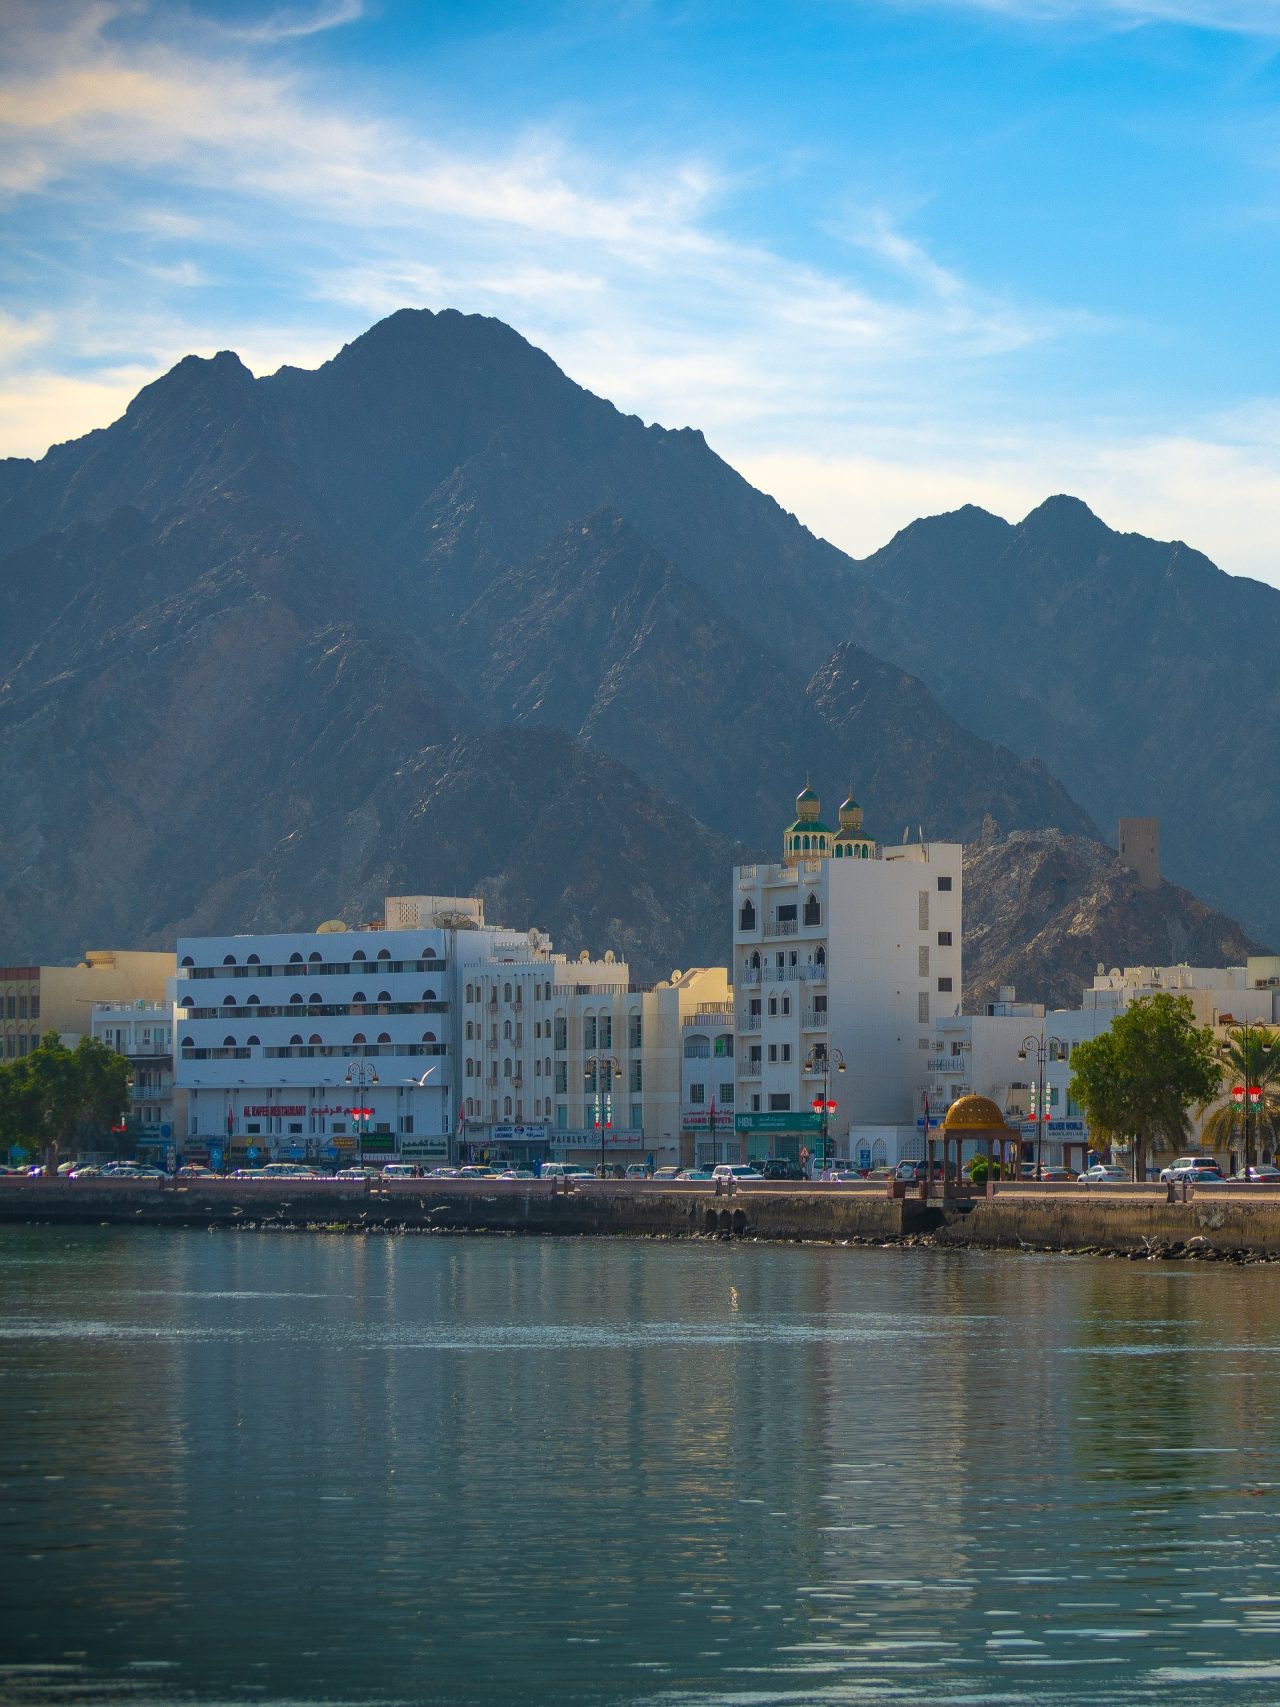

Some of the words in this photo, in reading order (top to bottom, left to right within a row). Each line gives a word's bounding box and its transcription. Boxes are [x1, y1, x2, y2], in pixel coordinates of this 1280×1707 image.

[243, 1106, 251, 1117] AL
[270, 1105, 307, 1117] RESTAURANT
[738, 1117, 753, 1127] HBL
[551, 1135, 588, 1144] PAISLEY
